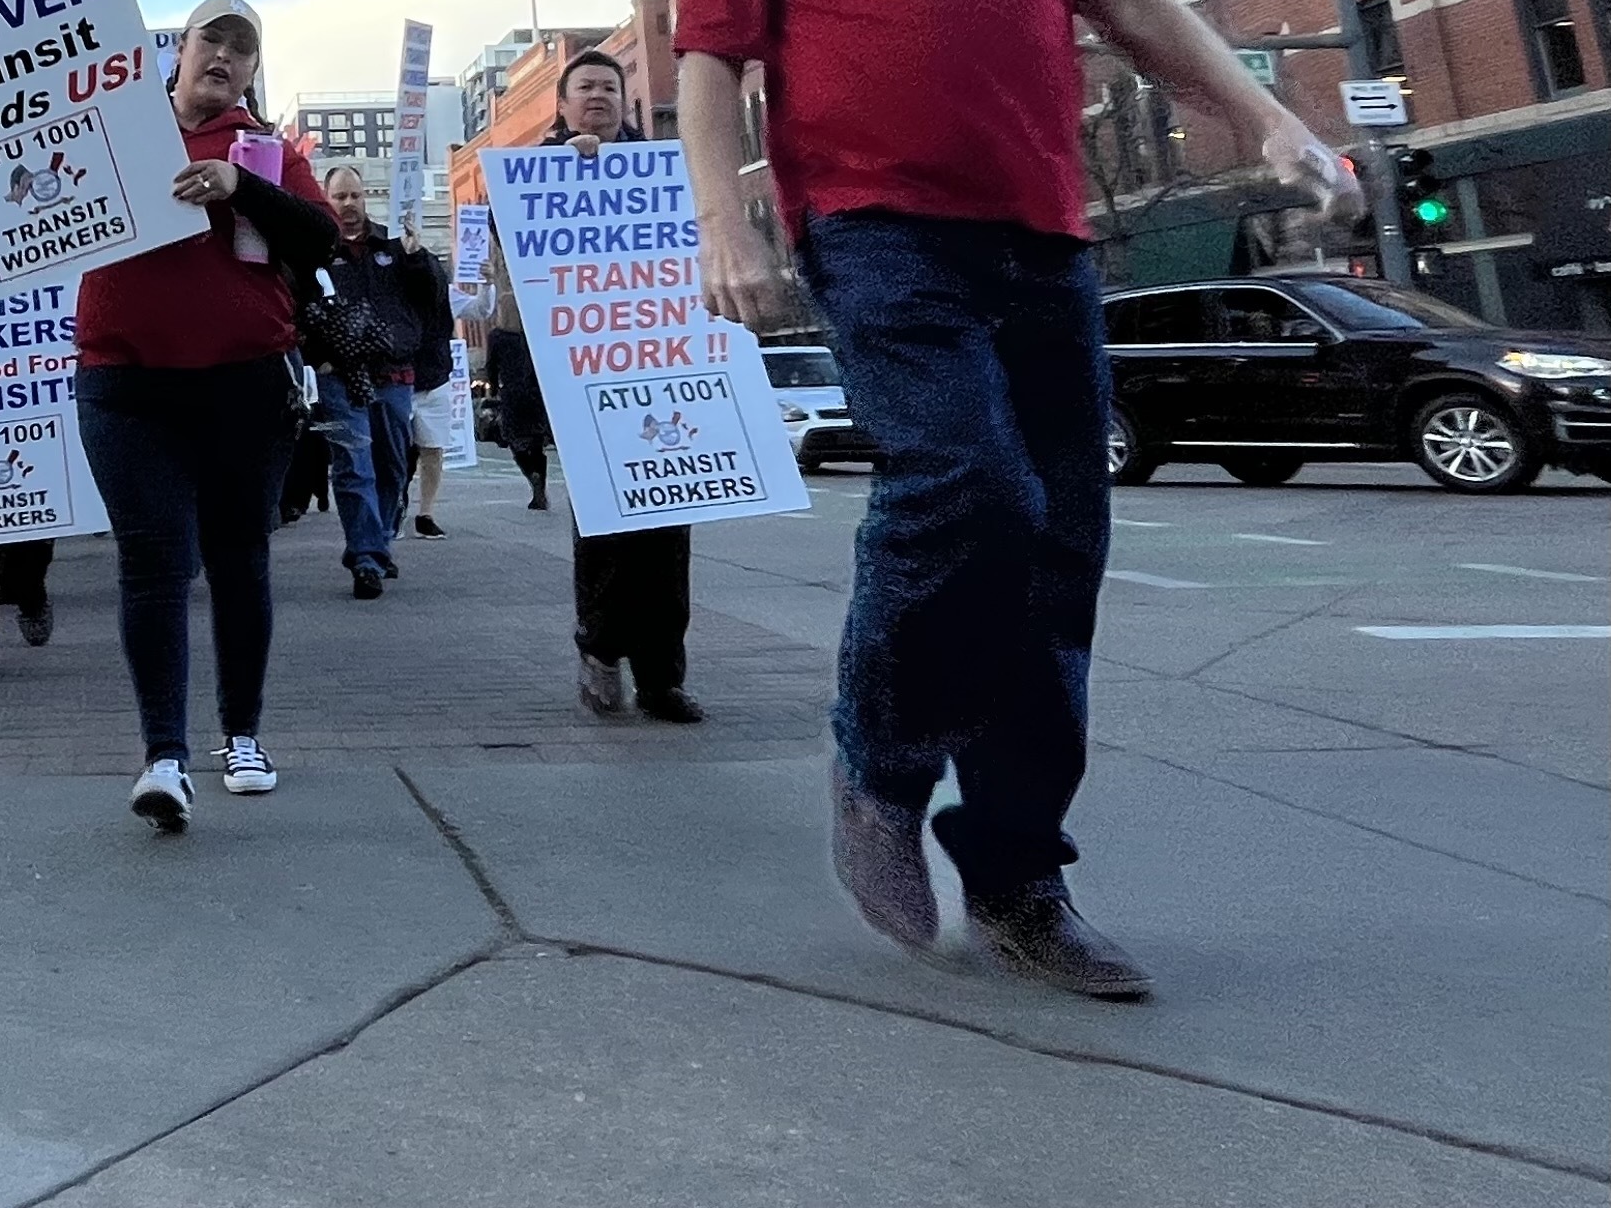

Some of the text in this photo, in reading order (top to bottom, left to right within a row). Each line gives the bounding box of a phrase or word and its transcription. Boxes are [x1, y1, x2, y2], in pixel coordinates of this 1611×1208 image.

[68, 45, 144, 104] US!
[33, 112, 95, 148] 1001
[503, 150, 680, 185] WITHOUT
[519, 185, 685, 220] TRANSIT
[1, 196, 110, 247] TRANSIT
[515, 220, 699, 258] WORKERS
[0, 216, 126, 270] WORKERS
[550, 295, 716, 337] DOESN'
[28, 354, 78, 375] For
[569, 332, 728, 377] WORK !!
[598, 377, 728, 412] ATU 1001
[624, 451, 738, 482] TRANSIT
[622, 476, 756, 509] WORKERS
